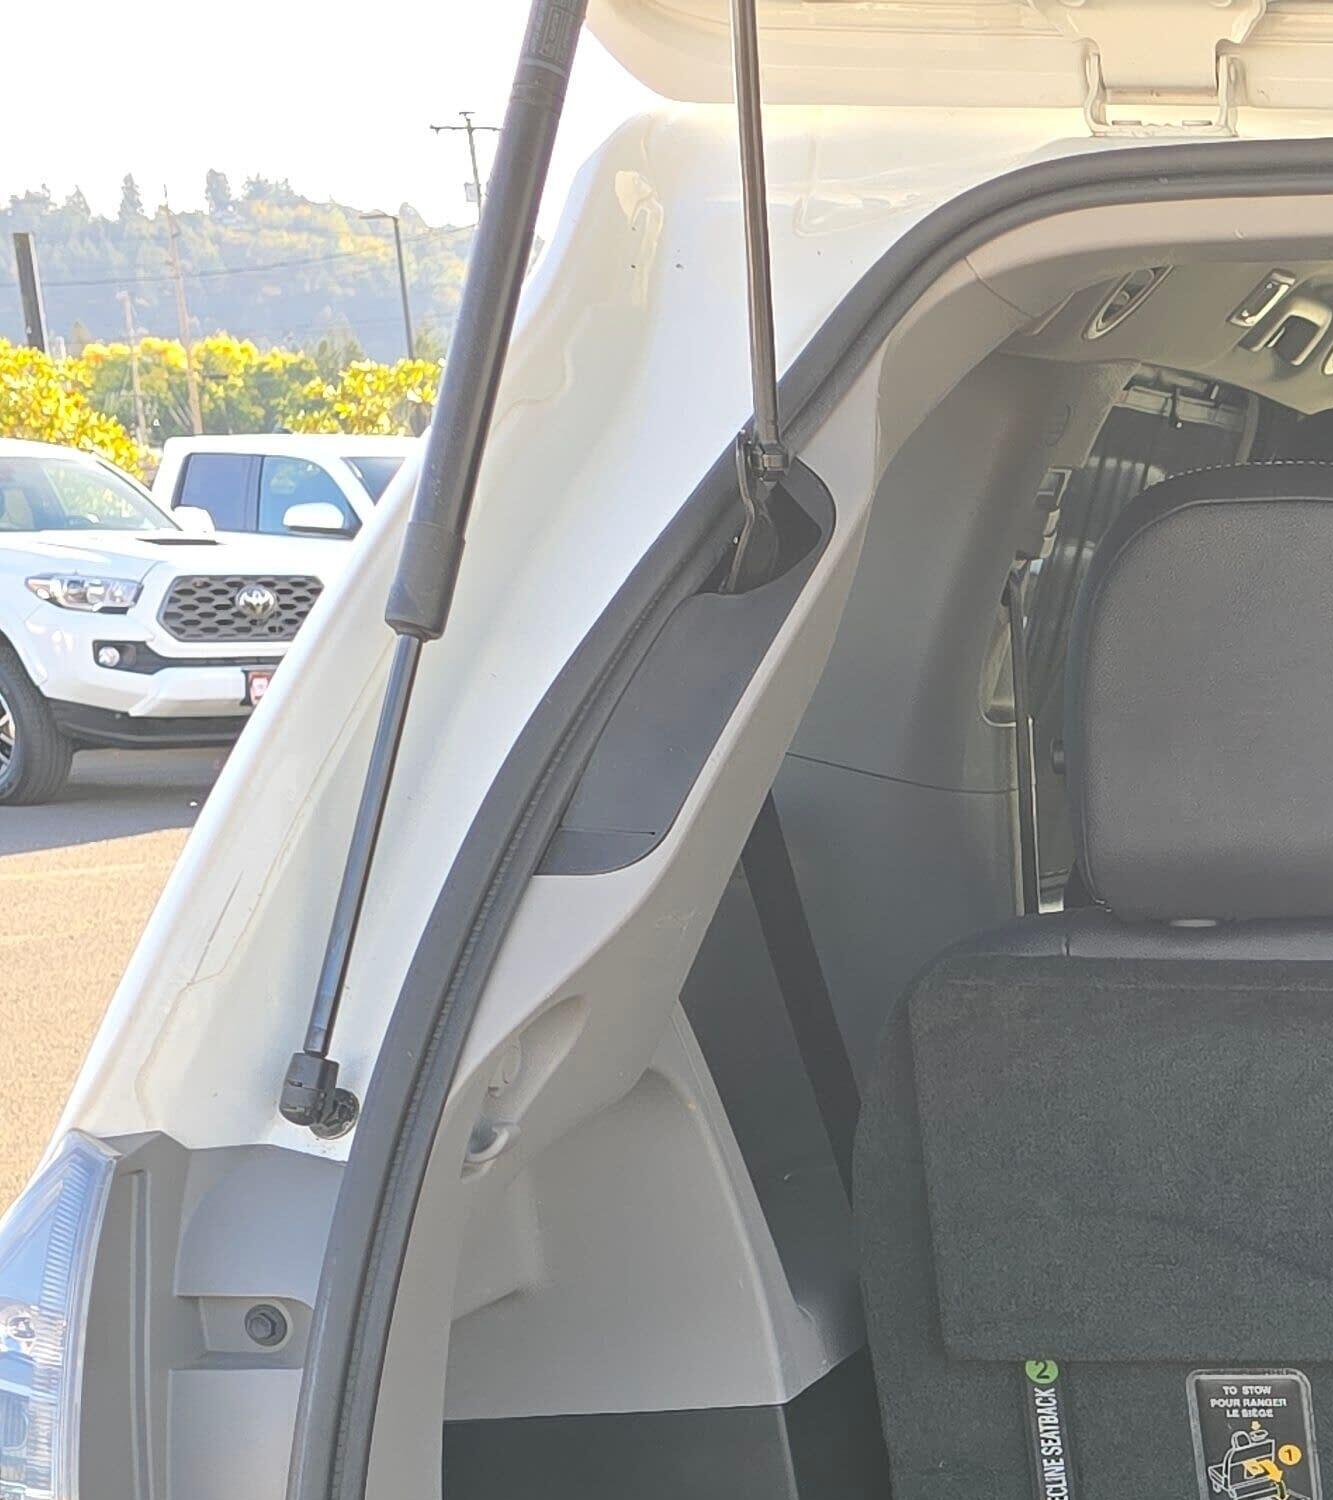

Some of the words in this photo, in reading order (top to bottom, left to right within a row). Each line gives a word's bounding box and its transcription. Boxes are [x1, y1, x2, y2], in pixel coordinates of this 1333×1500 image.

[1035, 1360, 1050, 1379] 2
[1223, 1386, 1237, 1395] TO
[1242, 1386, 1272, 1395] STOW
[1210, 1398, 1240, 1407] POUR
[1243, 1398, 1287, 1406] RANGER
[1226, 1409, 1240, 1417] LE
[1034, 1387, 1063, 1456] SEATBACK
